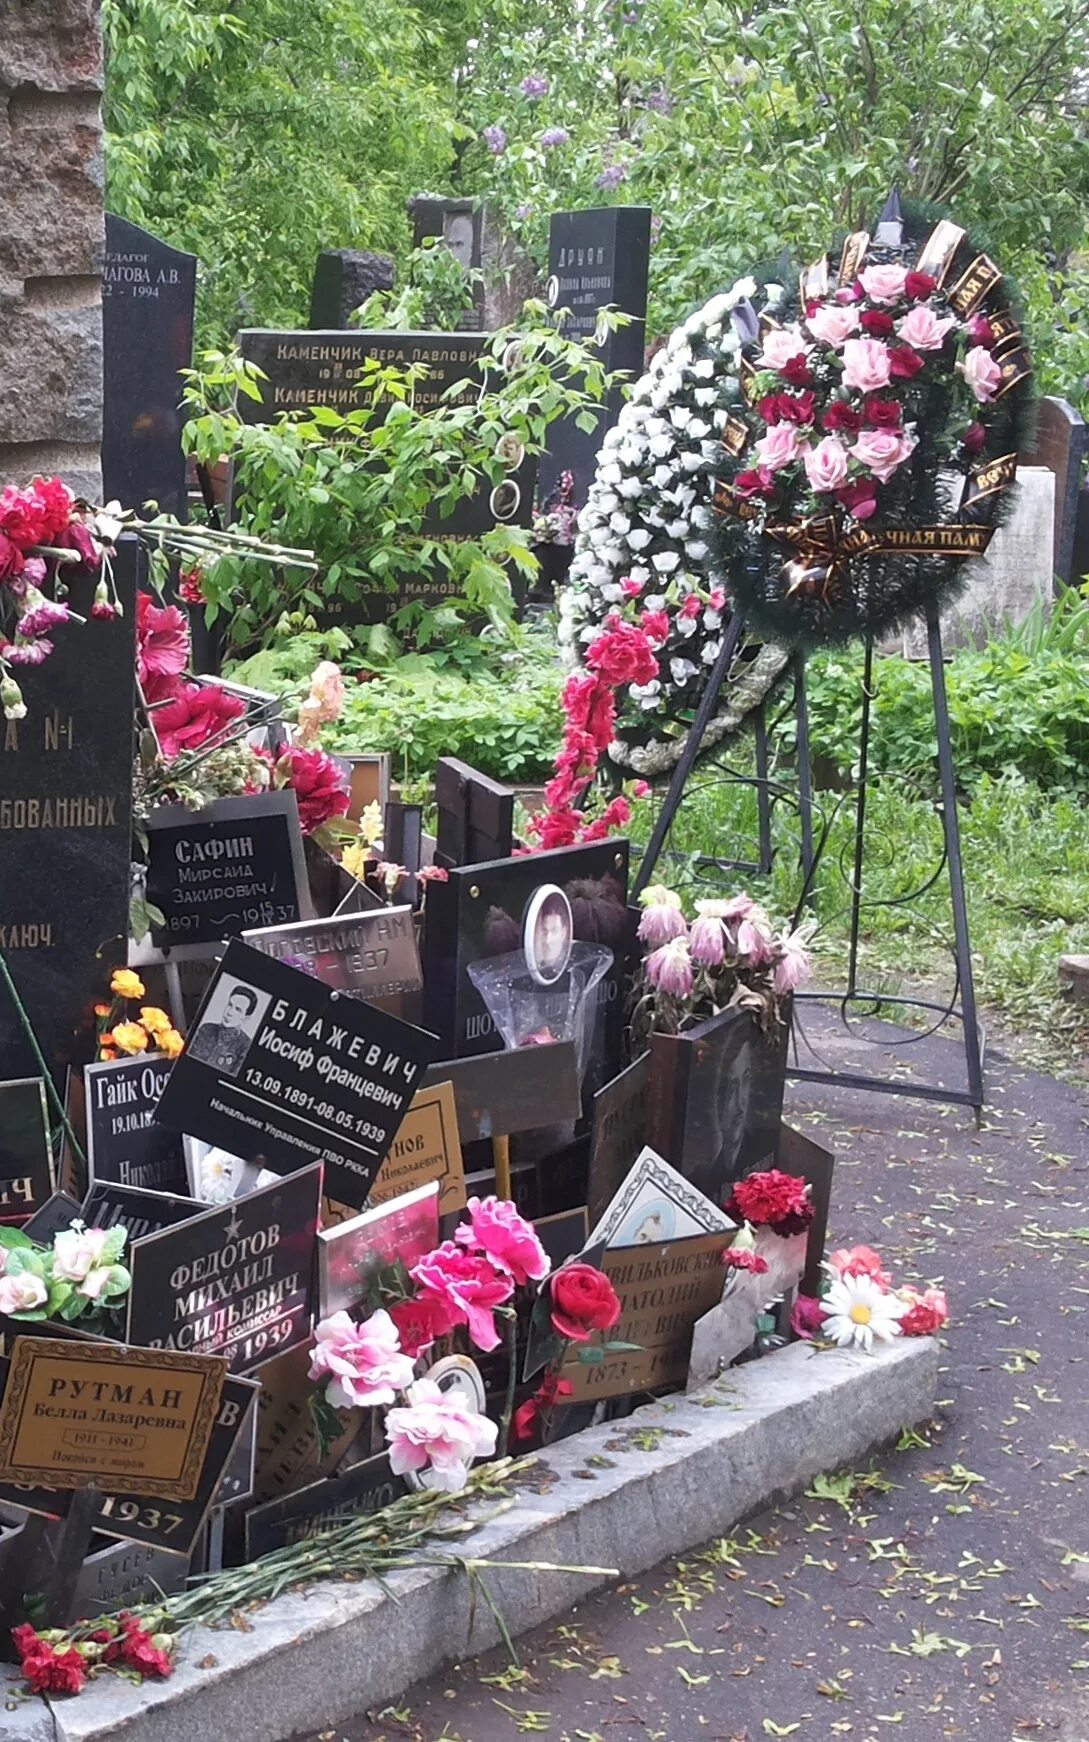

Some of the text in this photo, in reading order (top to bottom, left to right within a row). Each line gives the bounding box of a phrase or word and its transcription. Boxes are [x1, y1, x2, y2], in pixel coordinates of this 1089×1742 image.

[132, 285, 160, 297] 1994
[276, 344, 362, 362] КАМЕНЧИК
[369, 348, 405, 362] ВЕРА
[274, 387, 359, 405] КАМЕНЧИК
[175, 836, 254, 865] САФИН
[178, 868, 254, 885] МИРСАИД
[171, 884, 267, 905] ЗАКИРОВИЧ
[271, 999, 418, 1083] БЛАЖЕВИЧ
[257, 1026, 403, 1111] Иосиф Францевич
[96, 1075, 138, 1109] Гайк
[245, 1068, 386, 1143] 13.09.1891-08.05.1939
[210, 1098, 370, 1179] Начальник Управления ПВО РККА
[169, 1223, 281, 1290] ФЕДОТОВ
[173, 1253, 274, 1321] МИХАИЛ
[242, 1318, 294, 1361] 1939
[48, 1377, 184, 1410] РУТМАН
[33, 1402, 187, 1431] Белла Лазаревна
[98, 1495, 185, 1535] 1937
